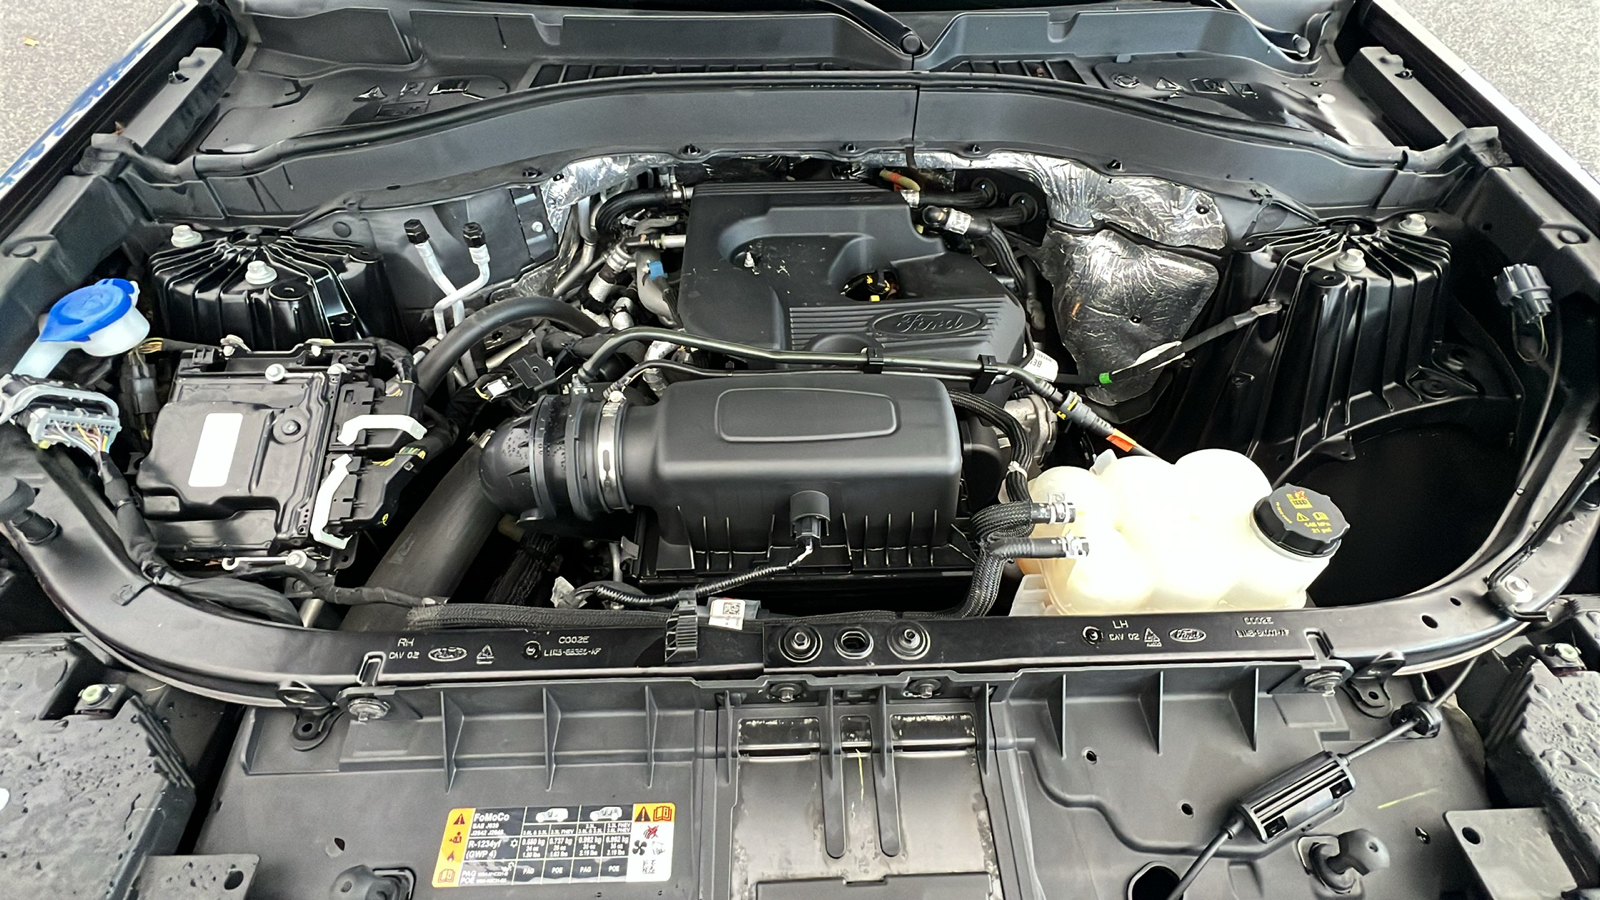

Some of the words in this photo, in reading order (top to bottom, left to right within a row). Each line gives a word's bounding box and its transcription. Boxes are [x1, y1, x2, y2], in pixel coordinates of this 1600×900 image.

[896, 312, 964, 333] Ford
[1112, 620, 1129, 629] LH
[1109, 633, 1124, 641] CAV
[1127, 633, 1140, 641] 02
[397, 637, 415, 647] RH
[388, 651, 405, 660] CAV
[406, 651, 420, 659] 02
[473, 812, 510, 822] FoMoCo
[468, 839, 501, 849] R-1234yf
[538, 838, 546, 847] kg
[565, 837, 573, 846] kg
[594, 836, 602, 845] kg
[621, 836, 629, 844] kg
[465, 850, 488, 859] (GWP
[489, 849, 497, 858] 4)
[523, 867, 535, 875] PAG
[460, 877, 475, 885] POE
